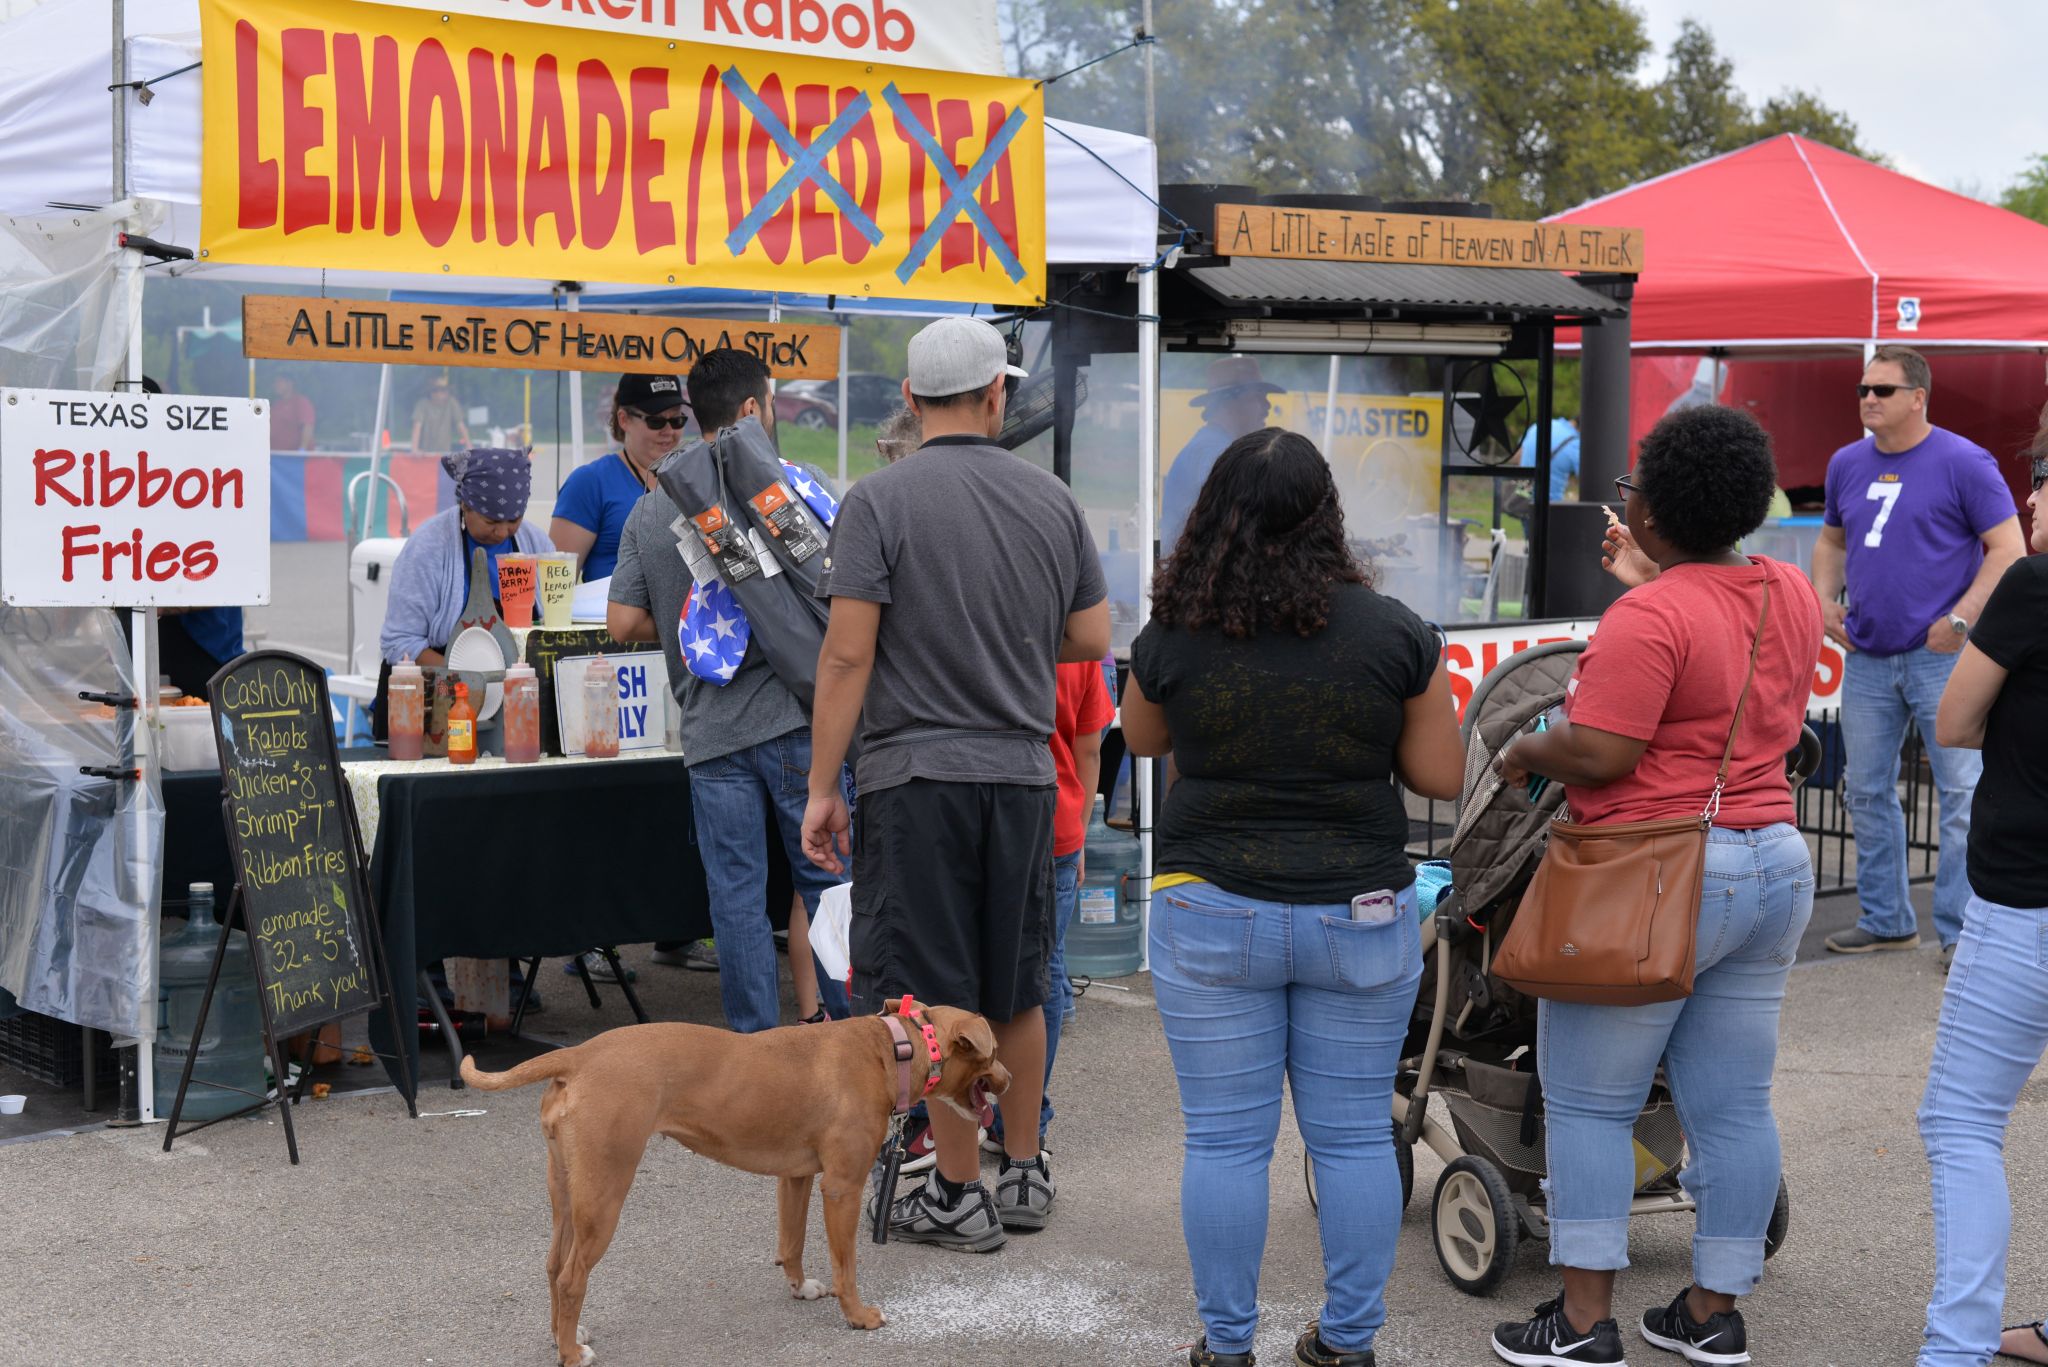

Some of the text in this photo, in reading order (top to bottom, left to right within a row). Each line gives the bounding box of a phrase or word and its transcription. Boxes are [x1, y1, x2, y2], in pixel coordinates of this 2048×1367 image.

[892, 92, 1020, 276] TEA
[1233, 210, 1253, 251] A
[1340, 215, 1395, 257] TASTE
[1441, 221, 1514, 262] HEAVEN
[1554, 229, 1569, 264] A
[287, 308, 319, 347] A
[420, 315, 497, 354] TASTE
[505, 318, 552, 355] OF
[560, 322, 654, 361] HEAVEN
[661, 326, 705, 363] ON
[49, 401, 229, 431] TEXAS SIZE
[33, 448, 244, 509] Ribbon
[1864, 482, 1903, 548] 7
[62, 524, 219, 582] Fries
[501, 577, 529, 589] BERRY
[222, 667, 317, 714] Cash Only
[617, 666, 647, 699] SH
[246, 721, 308, 755] Kabobs
[242, 843, 346, 890] Ribbon Fries
[266, 981, 325, 1015] Thank
